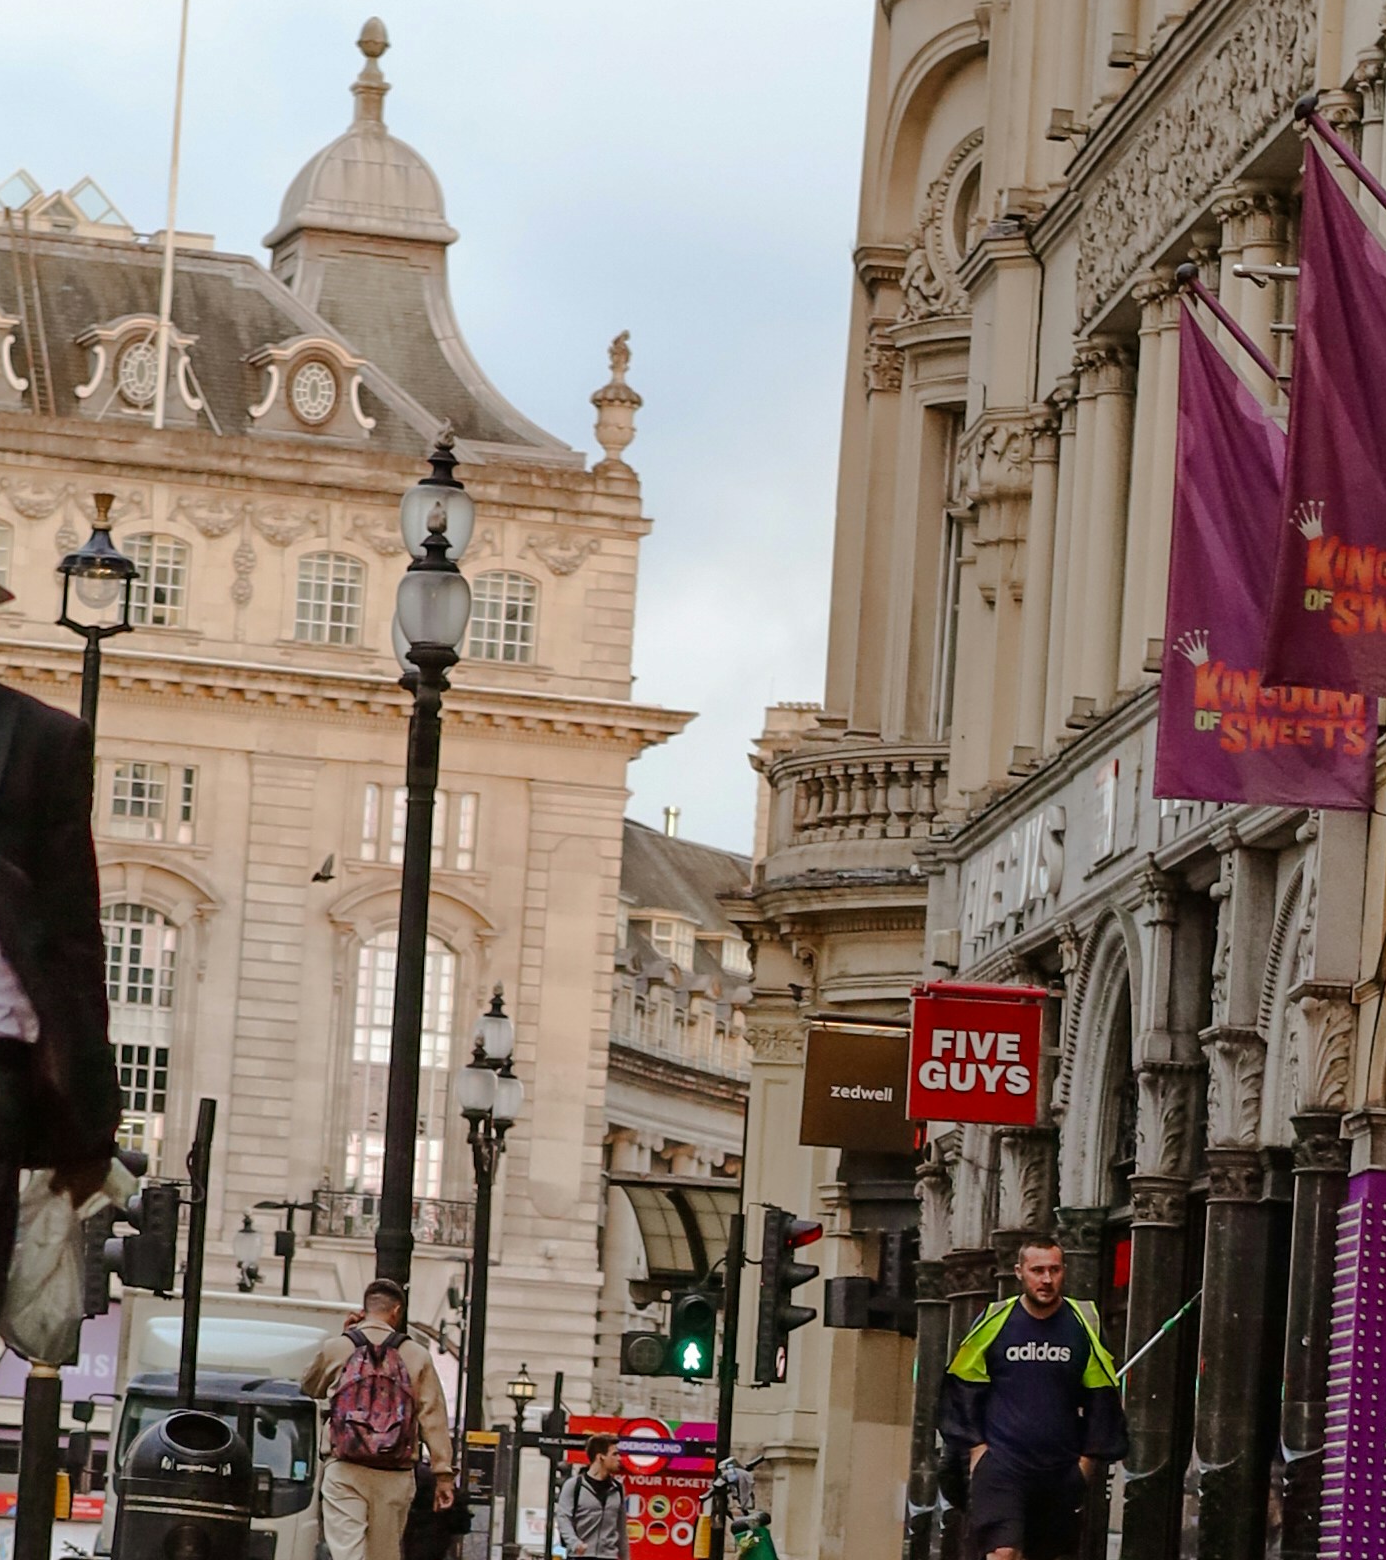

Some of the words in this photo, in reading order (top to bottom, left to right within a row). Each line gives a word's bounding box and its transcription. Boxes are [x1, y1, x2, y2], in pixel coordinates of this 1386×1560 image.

[1303, 588, 1333, 611] OF
[1194, 710, 1222, 731] OF
[1220, 712, 1366, 755] SWEETS
[931, 1029, 1021, 1062] FIVE
[918, 1060, 1031, 1095] GUYS
[830, 1084, 893, 1102] zedwell
[1006, 1342, 1071, 1362] adidas
[628, 1474, 662, 1486] YOUR
